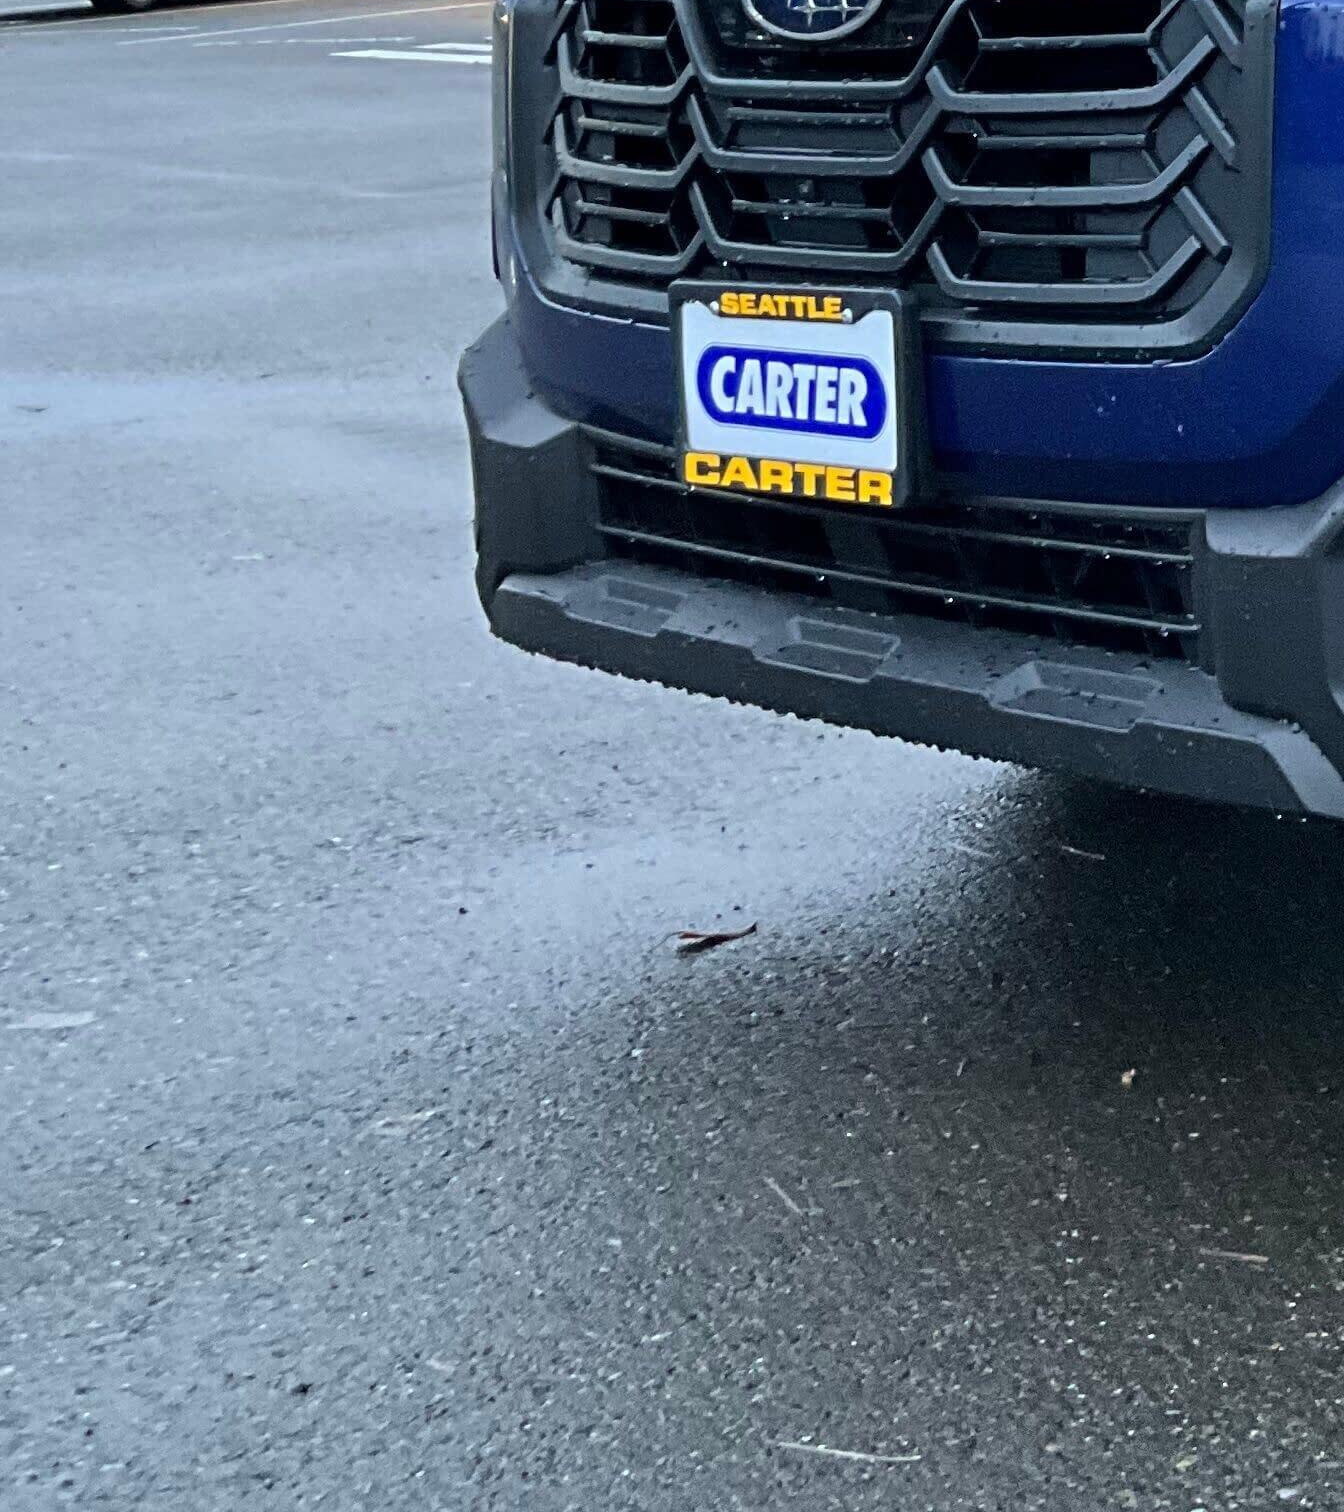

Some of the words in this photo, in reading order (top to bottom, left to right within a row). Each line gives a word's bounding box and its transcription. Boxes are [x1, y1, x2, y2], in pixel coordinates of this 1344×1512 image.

[719, 291, 844, 320] SEATTLE
[710, 354, 868, 427] CARTER
[684, 450, 894, 506] CARTER
